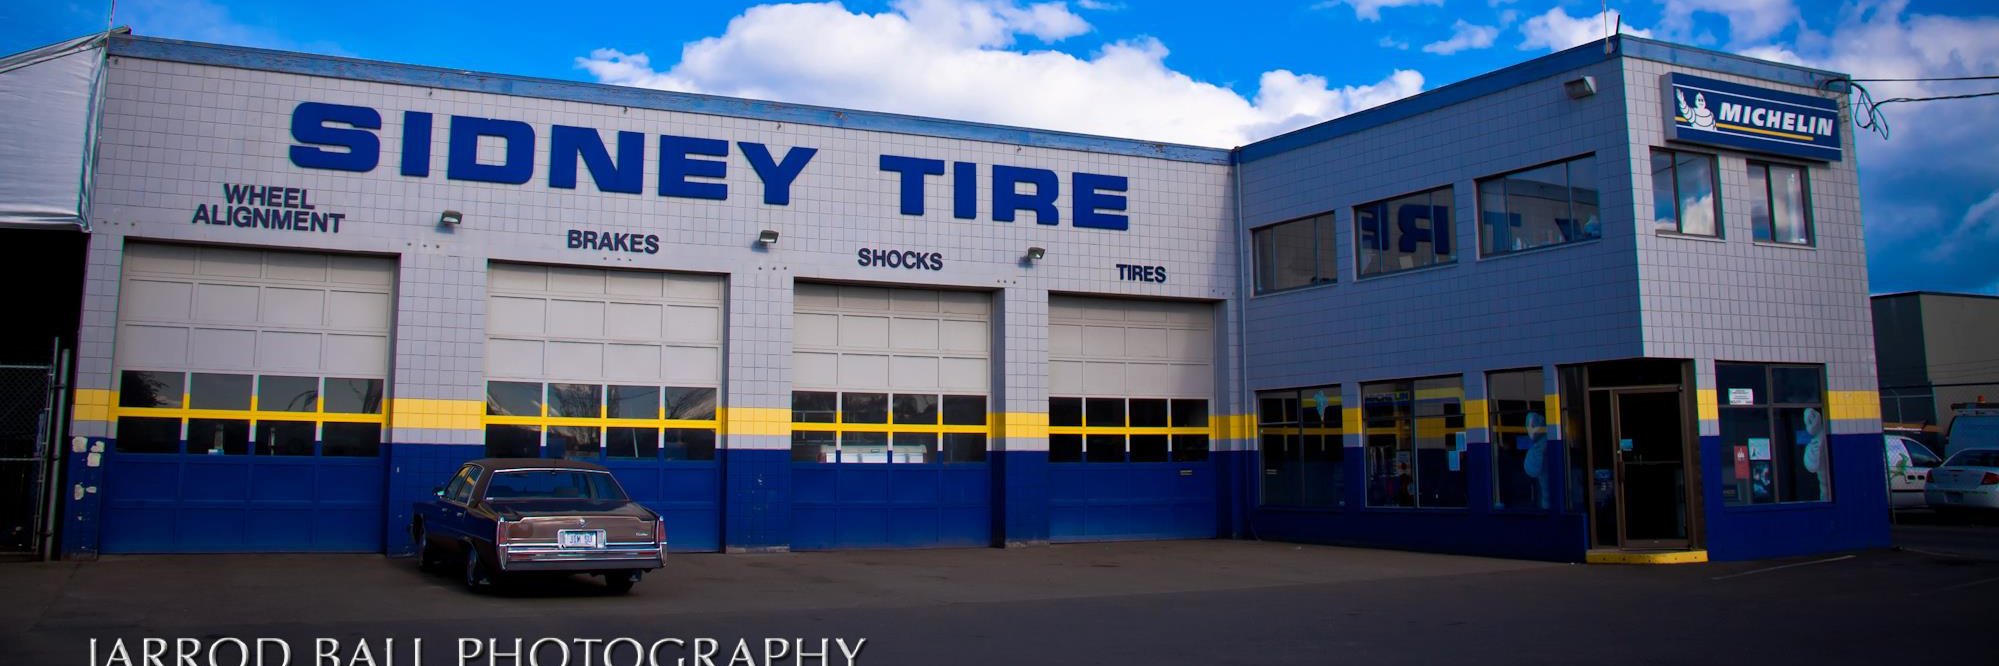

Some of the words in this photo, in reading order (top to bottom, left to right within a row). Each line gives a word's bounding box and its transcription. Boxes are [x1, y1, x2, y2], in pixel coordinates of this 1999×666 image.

[1719, 102, 1834, 137] MICHELIN
[290, 101, 818, 206] SIDNEY
[880, 154, 1129, 231] TIRE
[224, 183, 316, 210] WHEEL
[192, 203, 346, 234] ALIGNMENT
[566, 229, 660, 255] BRAKES
[857, 247, 944, 272] SHOCKS
[1116, 263, 1167, 284] TIRES
